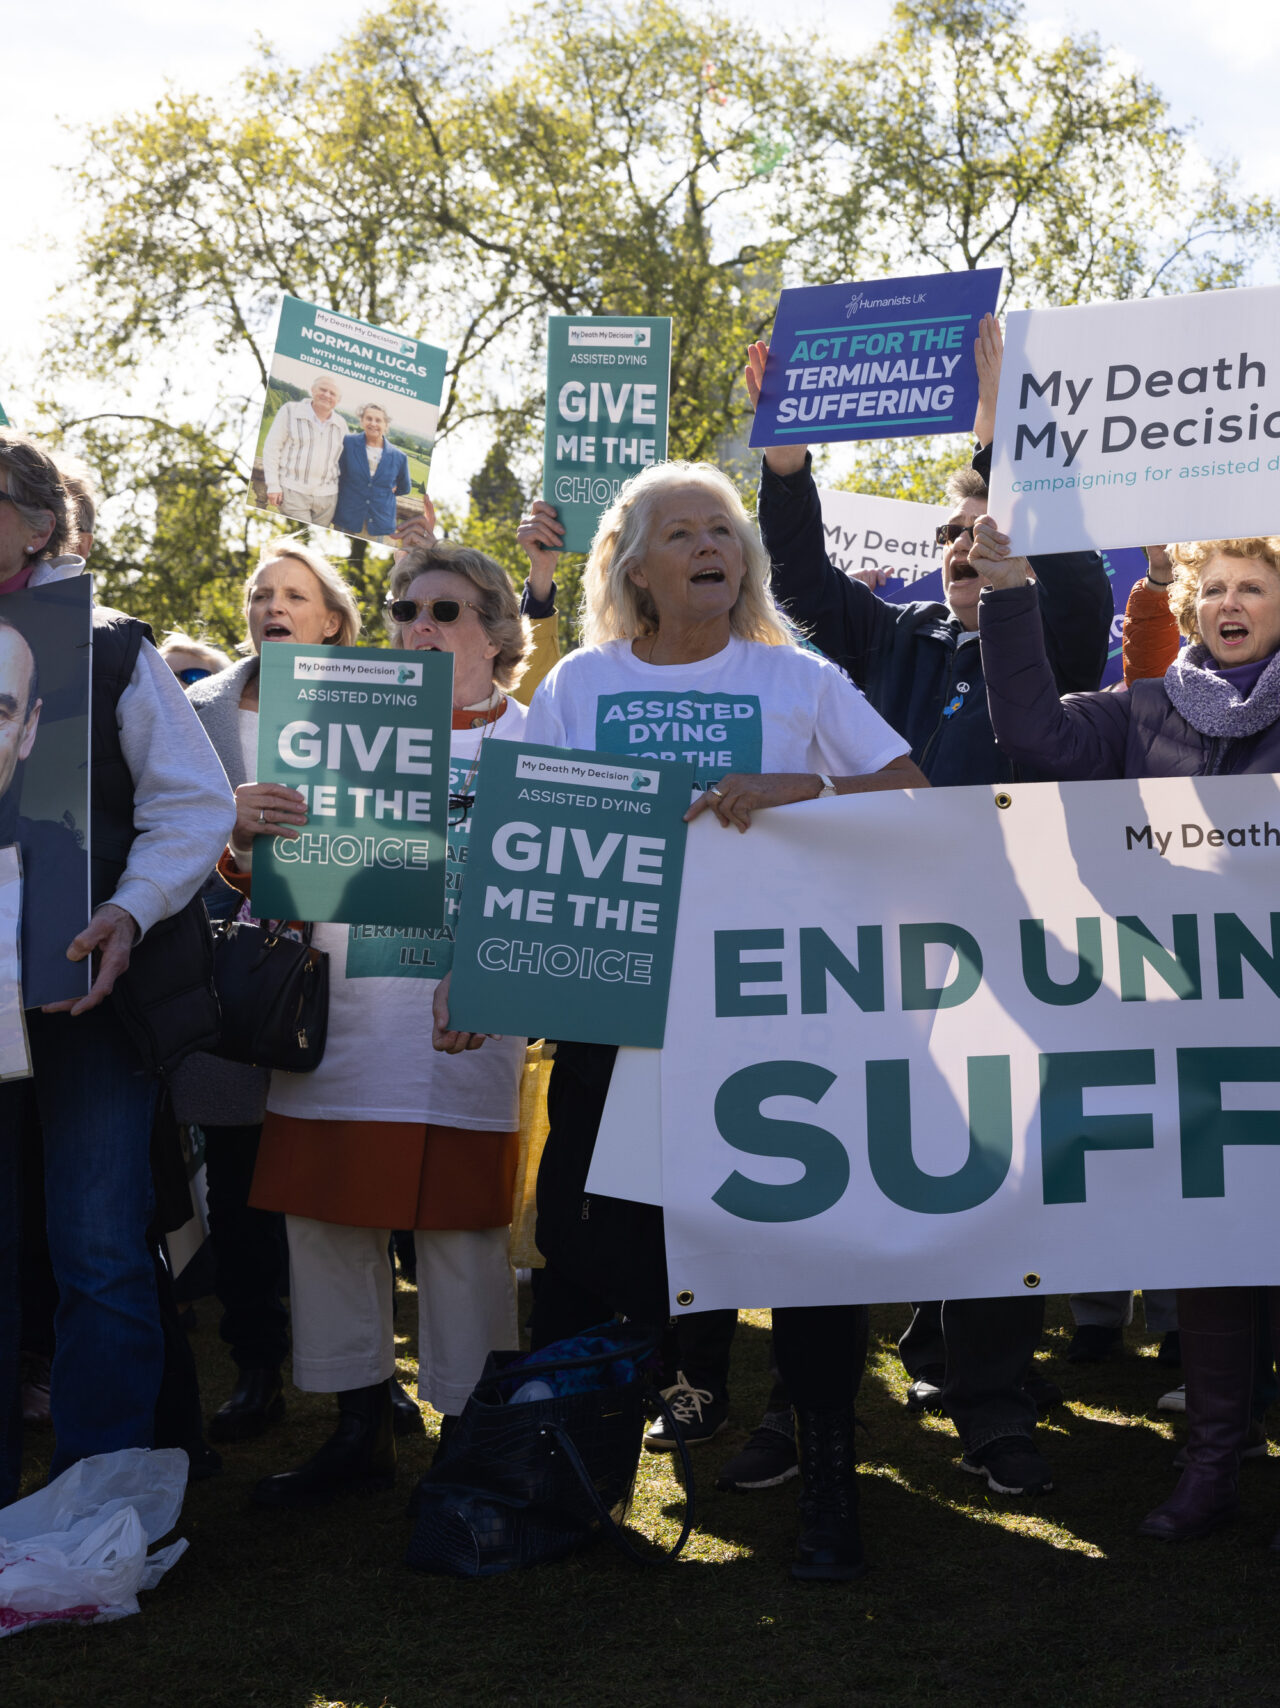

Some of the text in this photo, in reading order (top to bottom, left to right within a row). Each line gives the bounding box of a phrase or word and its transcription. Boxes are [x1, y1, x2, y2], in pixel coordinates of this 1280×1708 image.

[859, 293, 927, 309] Humanists UK
[329, 317, 354, 331] Death
[367, 330, 399, 346] Decision
[571, 331, 633, 340] My Death My Decision
[789, 325, 965, 363] ACT FOR THE
[301, 326, 428, 377] NORMAN LUCAS
[311, 346, 336, 360] WITH
[337, 355, 352, 366] HIS
[353, 360, 376, 374] WIFE
[570, 353, 648, 366] ASSISTED DYING
[300, 353, 418, 398] DIED A DRAWN OUT DEATH
[785, 354, 962, 391] TERMINALLY
[1019, 352, 1266, 415] My Death
[558, 380, 657, 425] GIVE
[776, 385, 955, 423] SUFFERING
[556, 434, 656, 466] ME THE
[1014, 421, 1088, 467] My
[554, 475, 621, 505] CHOI
[1011, 469, 1137, 493] campaigning
[1144, 466, 1172, 482] for
[1179, 457, 1260, 479] assisted
[864, 530, 943, 560] Death
[298, 662, 396, 676] My Death My Decision
[297, 688, 417, 707] ASSISTED DYING
[603, 700, 755, 724] ASSISTED
[277, 720, 433, 775] GIVE
[629, 722, 728, 744] DYING
[521, 760, 629, 781] My Death My Decision
[348, 787, 431, 822] THE
[518, 788, 652, 814] ASSISTED DYING
[273, 833, 429, 871] CHOICE
[491, 820, 667, 886] GIVE
[1125, 825, 1172, 856] My
[483, 885, 556, 923] ME
[567, 894, 660, 934] THE
[350, 923, 456, 942] TERMINA
[400, 947, 437, 967] ILL
[477, 937, 654, 986] CHOICE
[714, 922, 984, 1018] END
